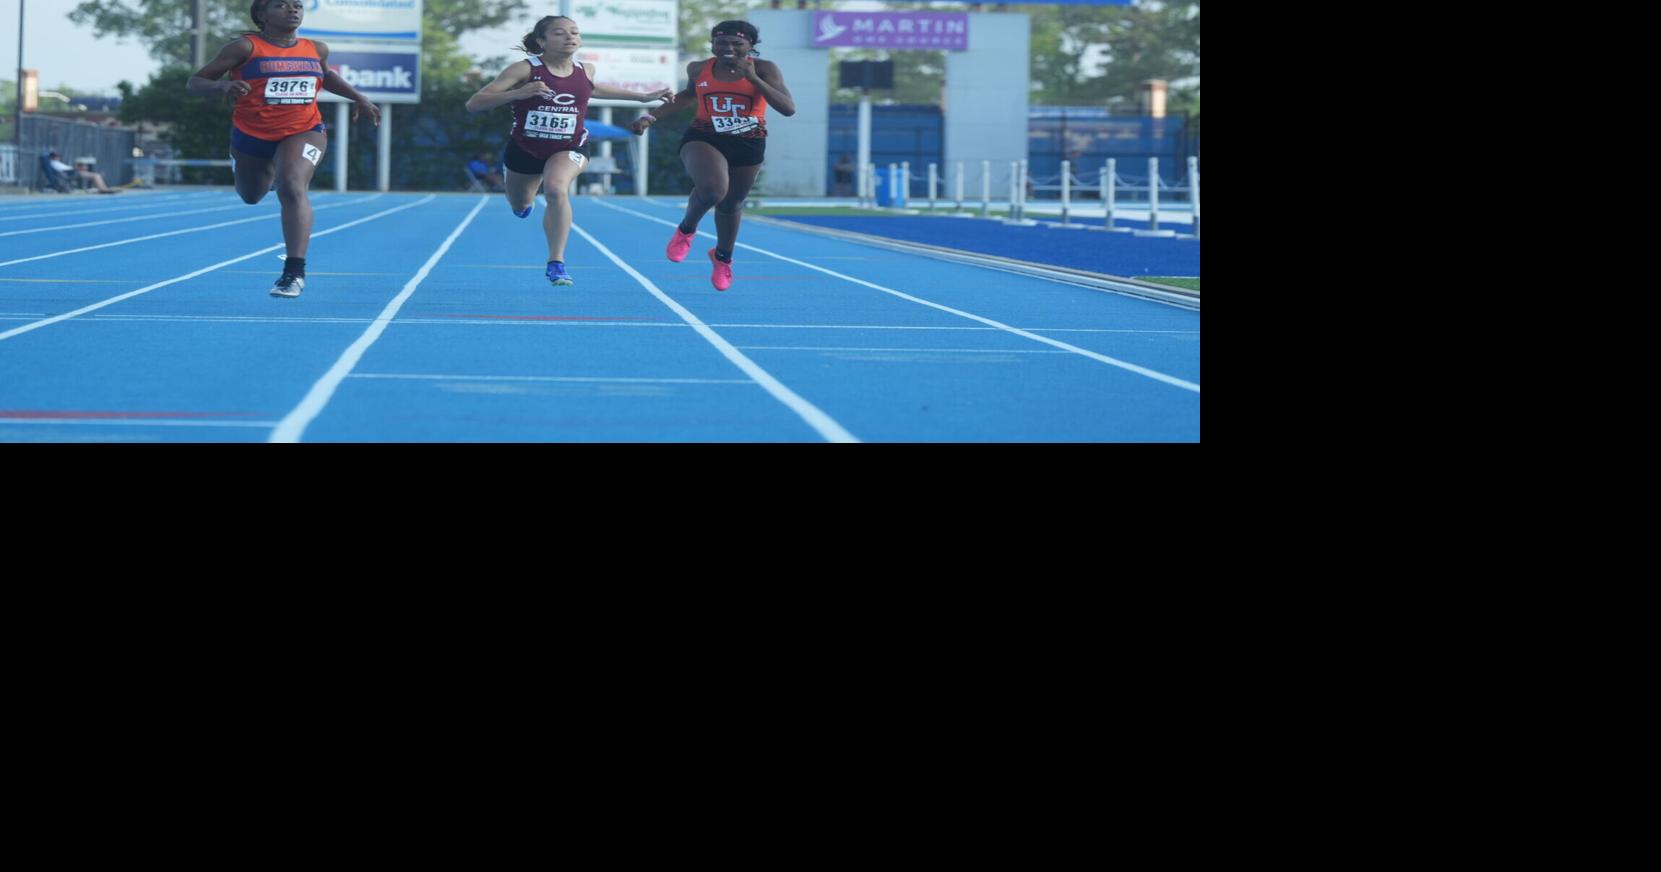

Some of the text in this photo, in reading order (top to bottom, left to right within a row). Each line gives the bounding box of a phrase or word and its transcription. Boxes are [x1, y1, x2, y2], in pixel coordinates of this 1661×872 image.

[852, 18, 965, 33] MARTIN
[341, 64, 413, 88] bank
[270, 80, 309, 92] 3976
[552, 93, 576, 105] C
[537, 105, 580, 113] CENTRAL
[529, 114, 569, 129] 3165
[307, 148, 317, 160] 4
